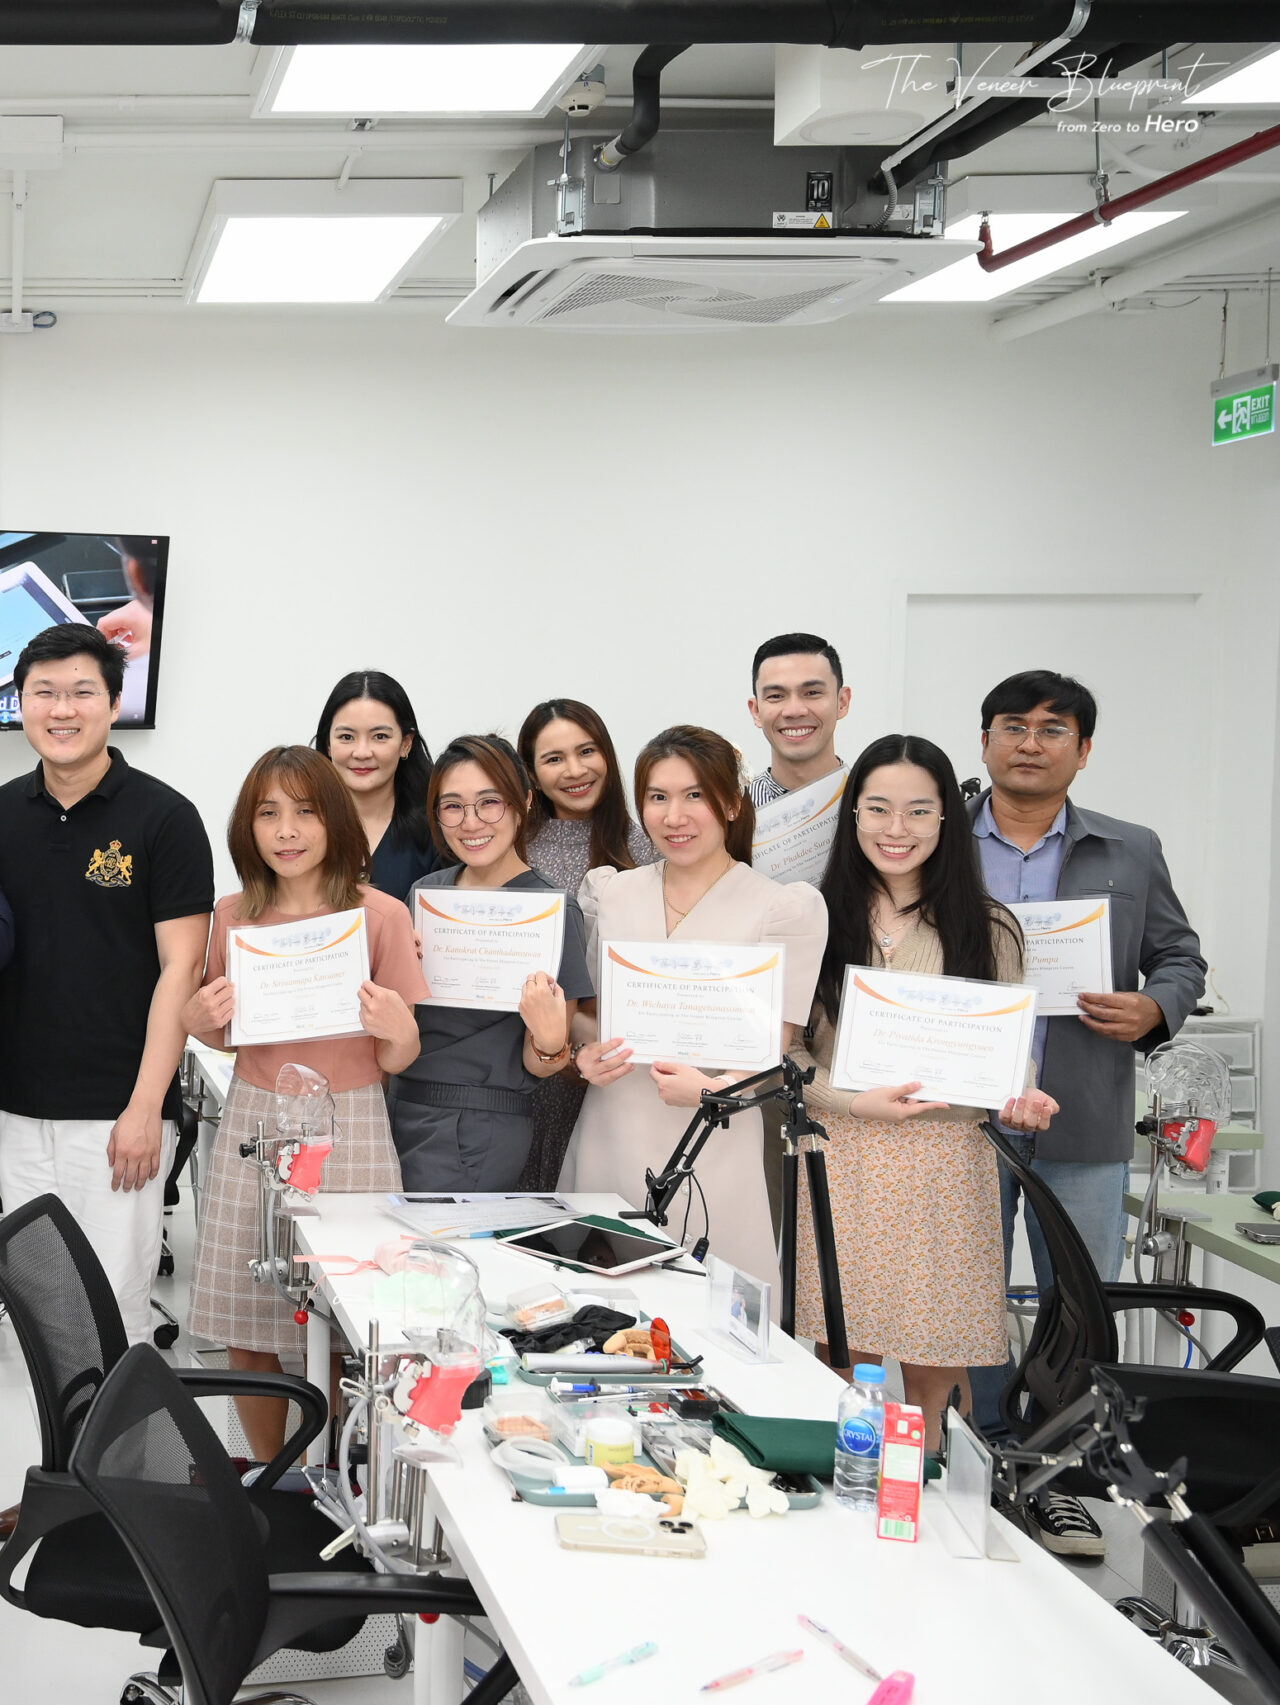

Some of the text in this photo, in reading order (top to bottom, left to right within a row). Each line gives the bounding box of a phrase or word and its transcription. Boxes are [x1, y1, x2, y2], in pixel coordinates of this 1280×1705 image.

[811, 180, 829, 199] 10
[1251, 394, 1270, 411] EXIT
[752, 841, 781, 861] IFICATE
[782, 837, 791, 846] OF
[433, 927, 476, 936] CERTIFICATE
[489, 929, 540, 939] PARTICIPATION
[1026, 937, 1084, 945] PARTICIPATION
[626, 981, 677, 990] CERTIFICATE
[868, 1008, 1003, 1033] CERTIFICATE OF PARTICIPATION
[844, 1428, 874, 1442] CRYSTAL
